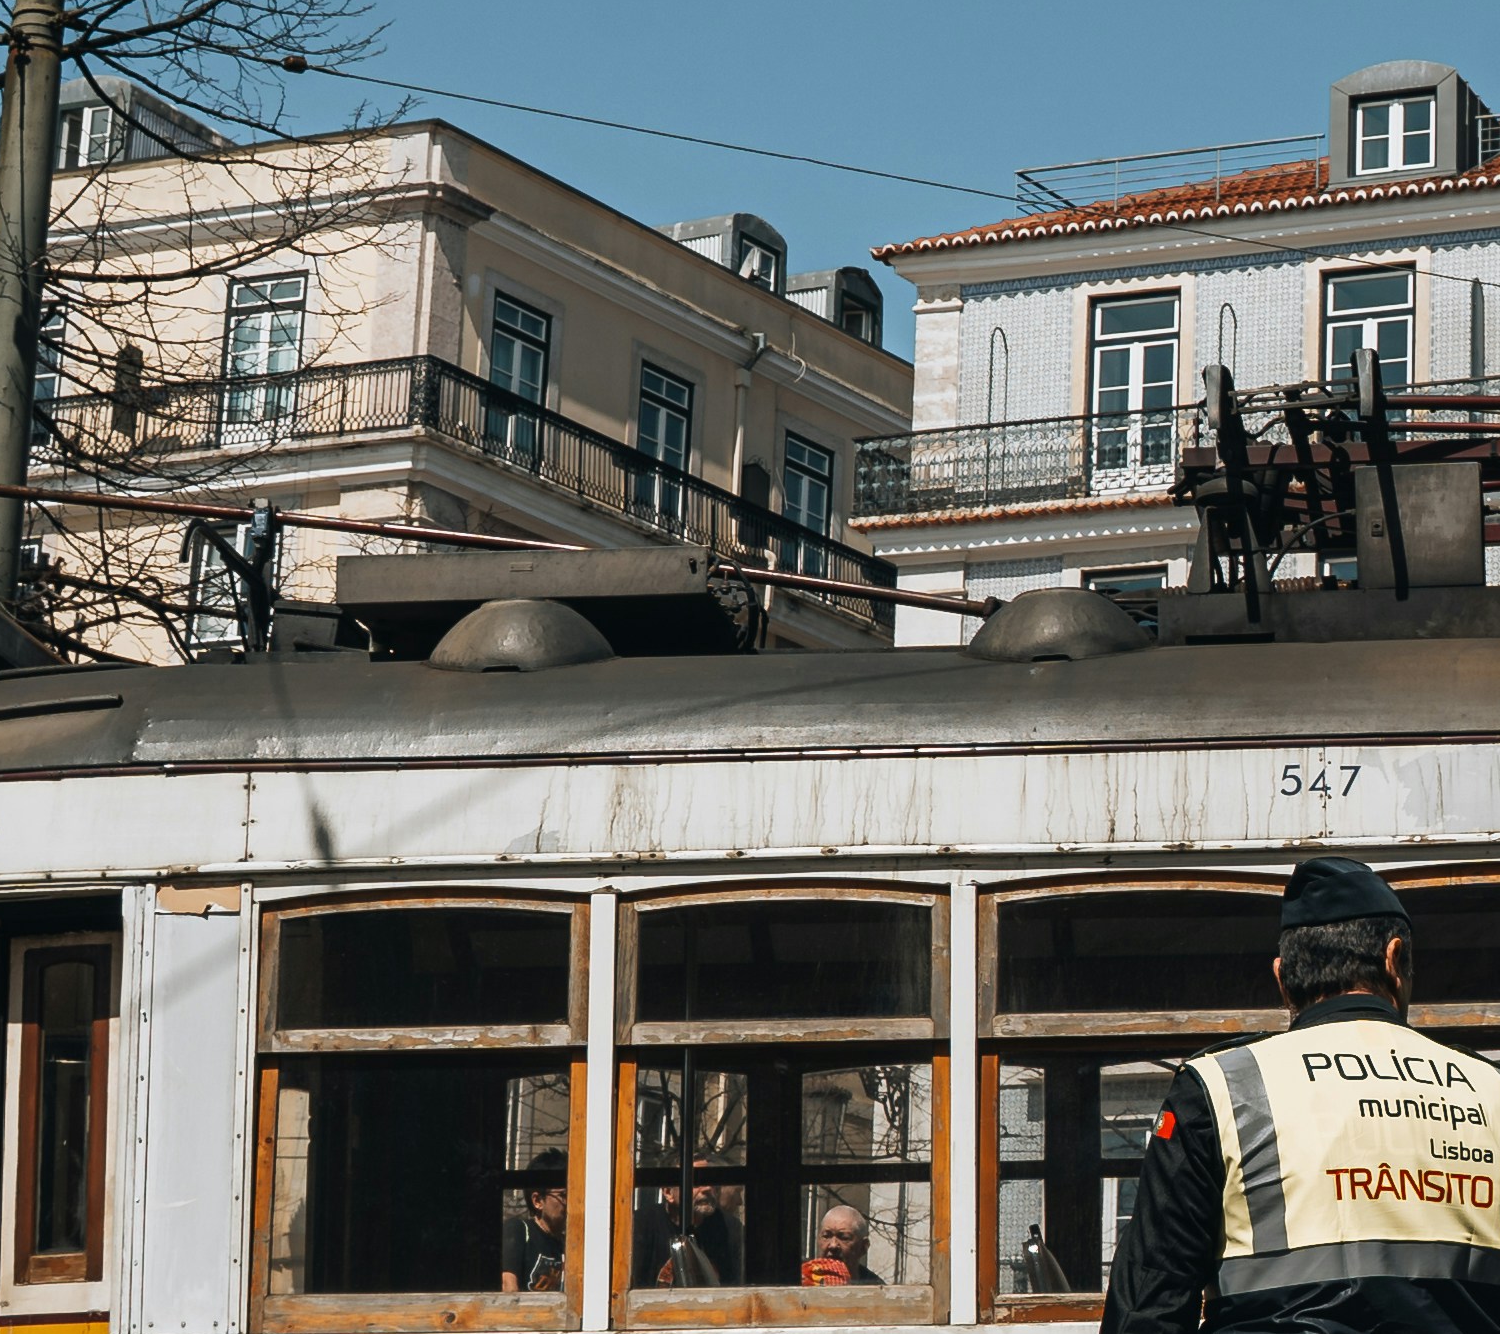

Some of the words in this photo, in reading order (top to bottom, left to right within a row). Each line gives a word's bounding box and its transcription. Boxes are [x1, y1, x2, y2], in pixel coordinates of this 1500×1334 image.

[1280, 763, 1362, 798] 547
[1301, 1049, 1476, 1093] POLÍCIA
[1359, 1096, 1488, 1131] municipal
[1430, 1138, 1494, 1164] Lisboa
[1326, 1162, 1494, 1209] TRÂNSITO
